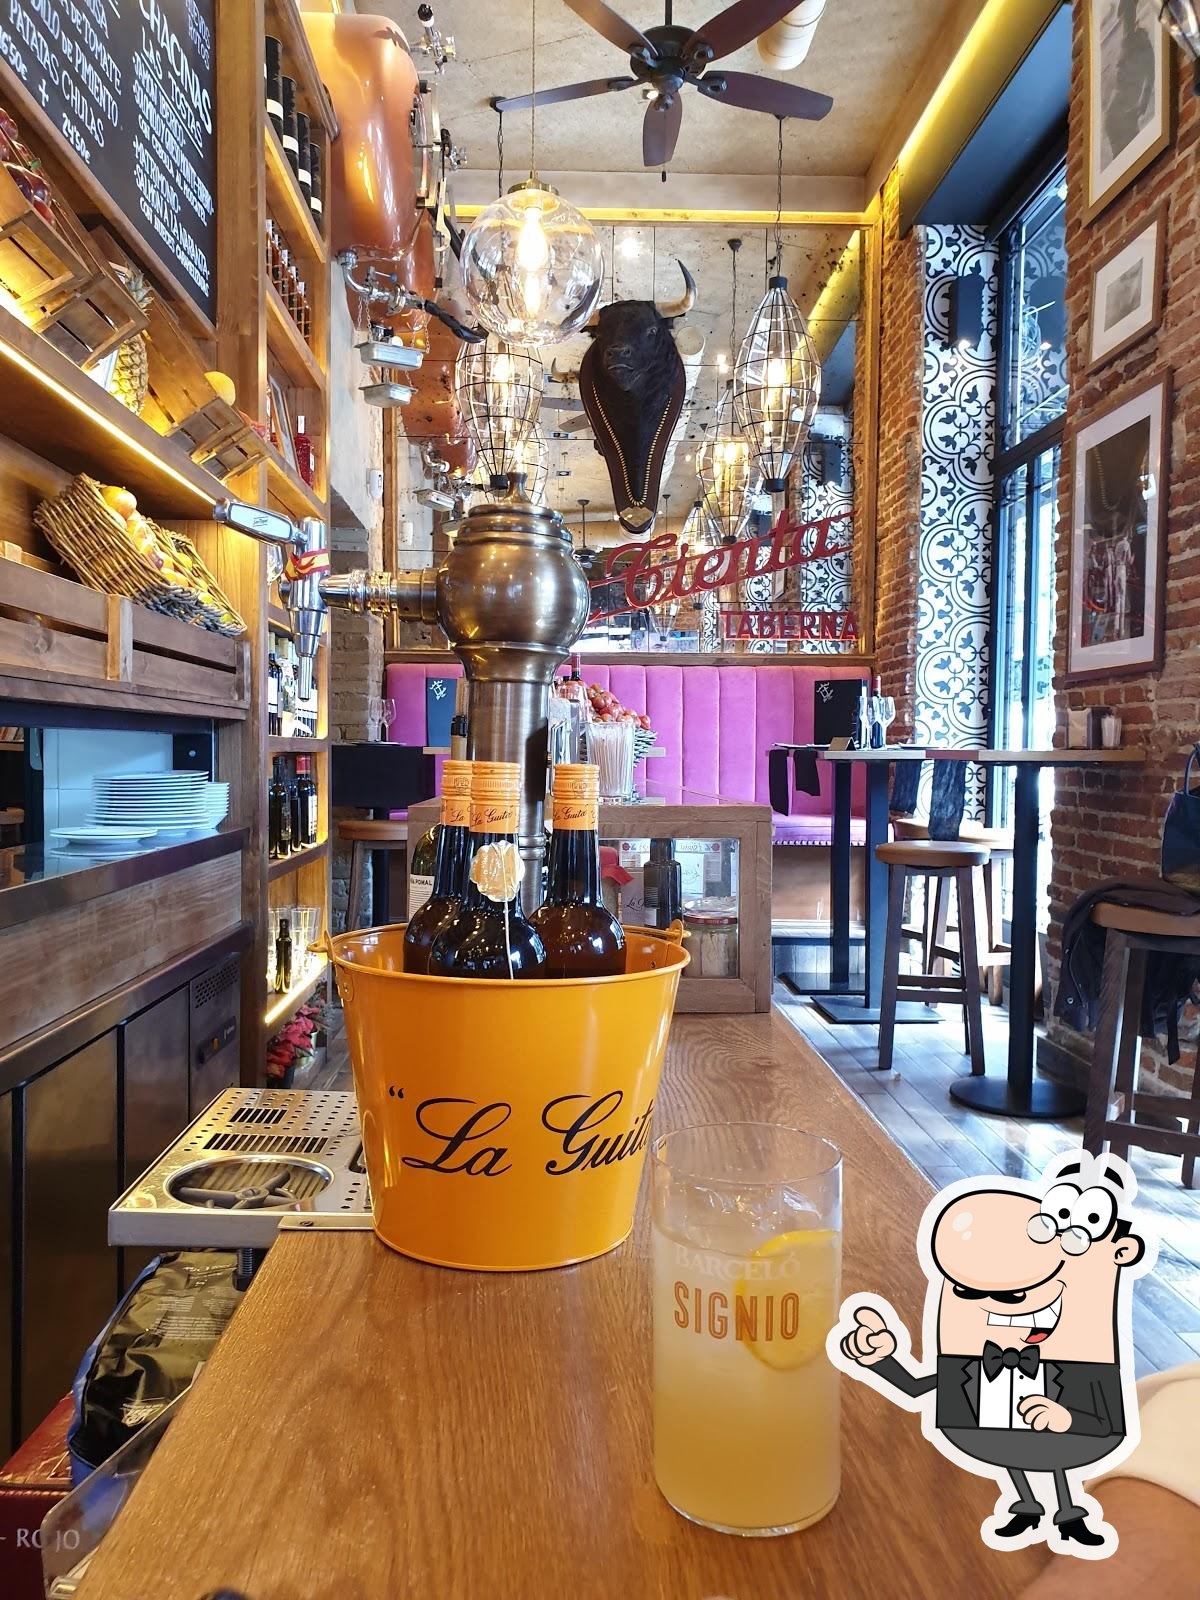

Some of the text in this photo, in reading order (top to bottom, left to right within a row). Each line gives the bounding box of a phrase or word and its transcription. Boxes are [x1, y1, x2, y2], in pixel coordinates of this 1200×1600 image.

[9, 0, 104, 148] PATATAS CHULAS
[61, 30, 73, 63] DE
[74, 40, 118, 127] PIMIENTO
[82, 12, 121, 95] TOMATE
[141, 26, 203, 147] LAS TOSTAS
[719, 611, 859, 640] TABERNA
[674, 1243, 800, 1281] BARCELÓ
[674, 1281, 800, 1342] SIGNIO
